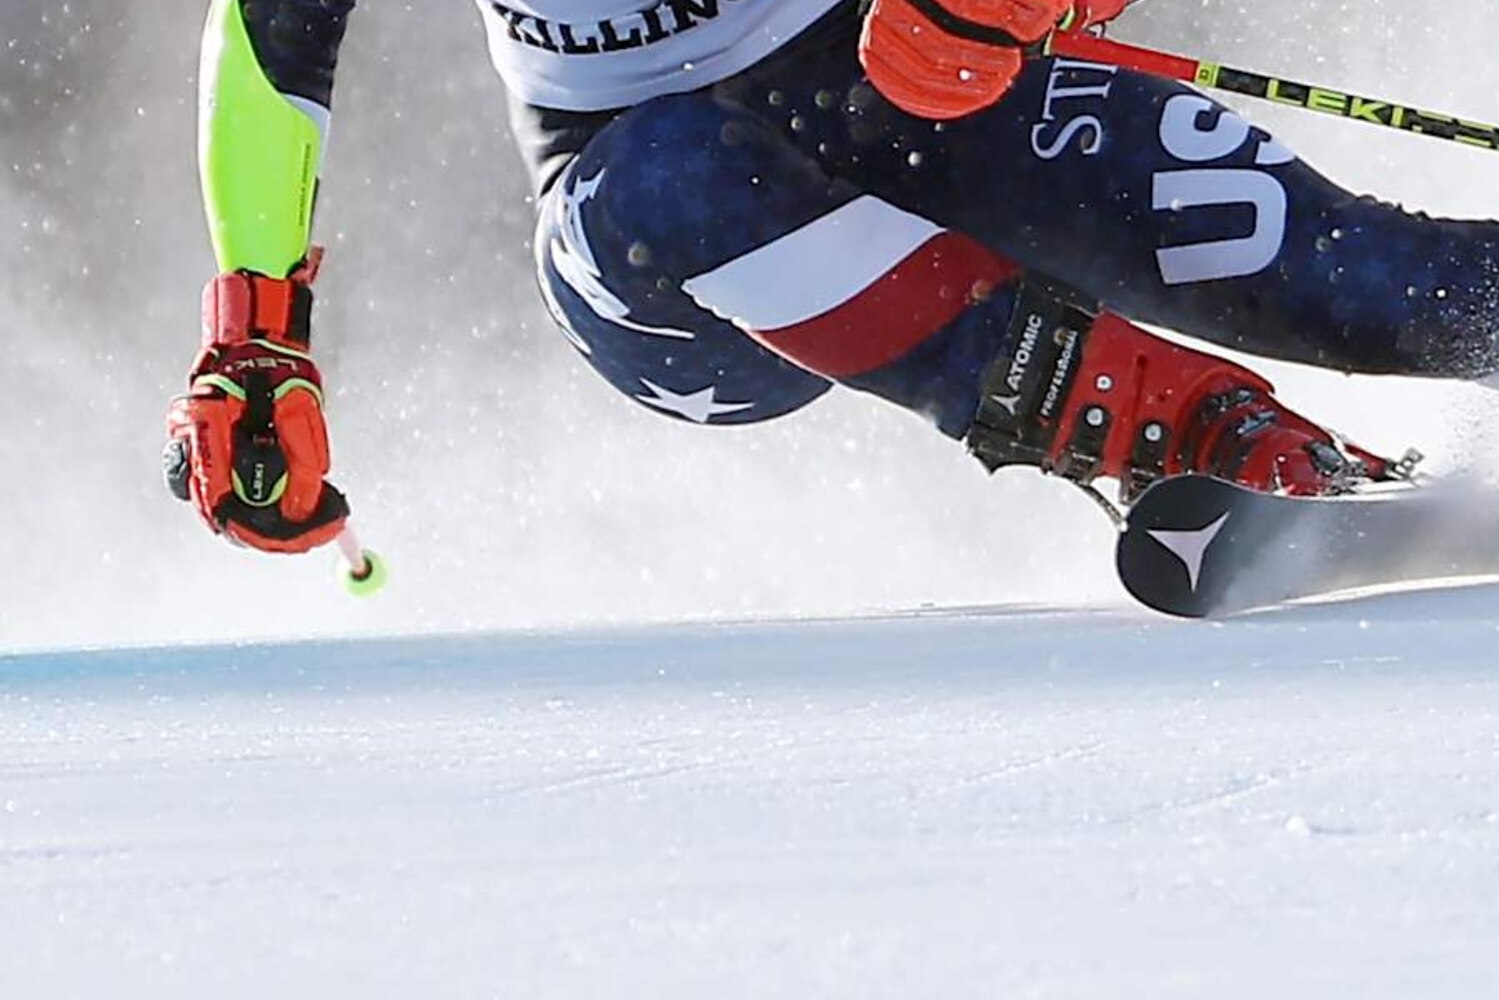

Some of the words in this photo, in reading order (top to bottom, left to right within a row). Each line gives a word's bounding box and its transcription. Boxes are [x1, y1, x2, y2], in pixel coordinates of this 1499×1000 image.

[1030, 57, 1118, 160] STI
[1266, 77, 1404, 127] LEKI
[1007, 314, 1041, 392] ATOMIC
